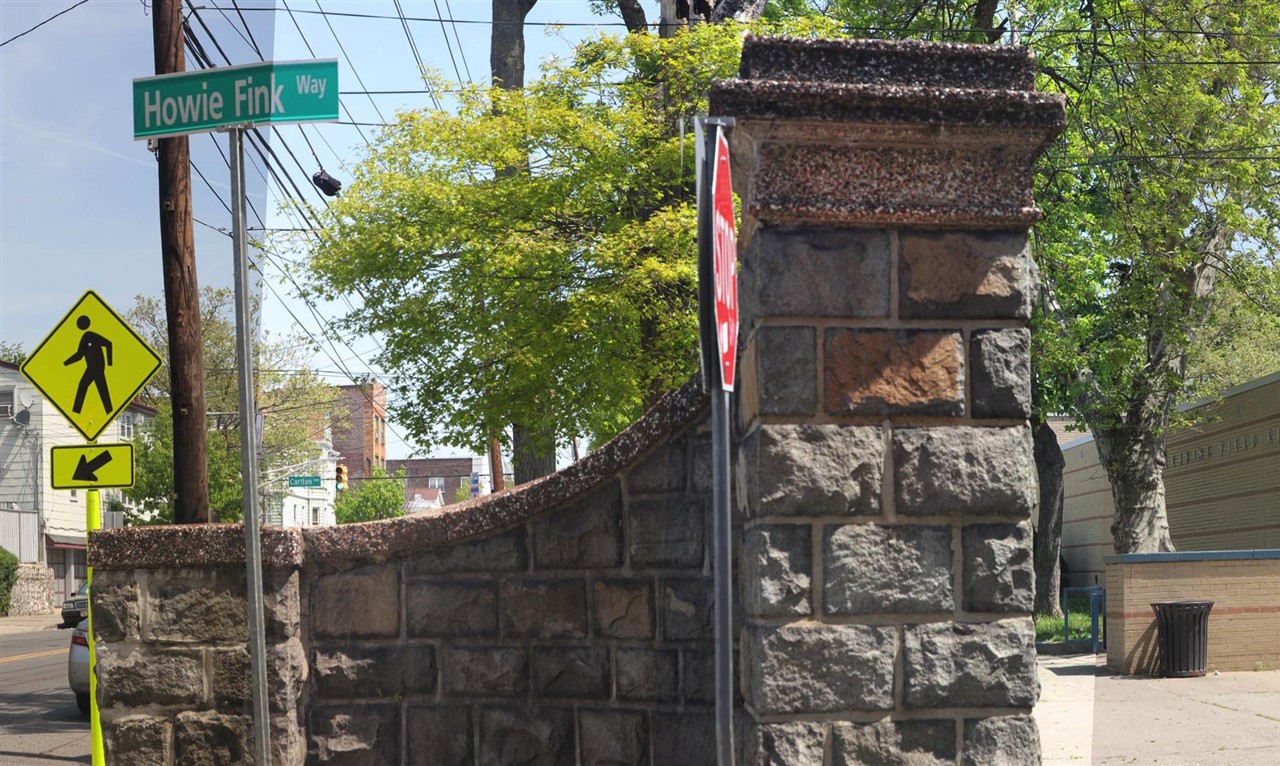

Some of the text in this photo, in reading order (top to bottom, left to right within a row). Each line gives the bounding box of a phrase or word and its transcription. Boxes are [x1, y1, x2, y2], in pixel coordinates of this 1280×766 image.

[144, 73, 327, 128] Howie Fink Way
[715, 208, 736, 311] STOP
[1220, 433, 1257, 458] FIELD
[290, 478, 312, 486] Carlton
